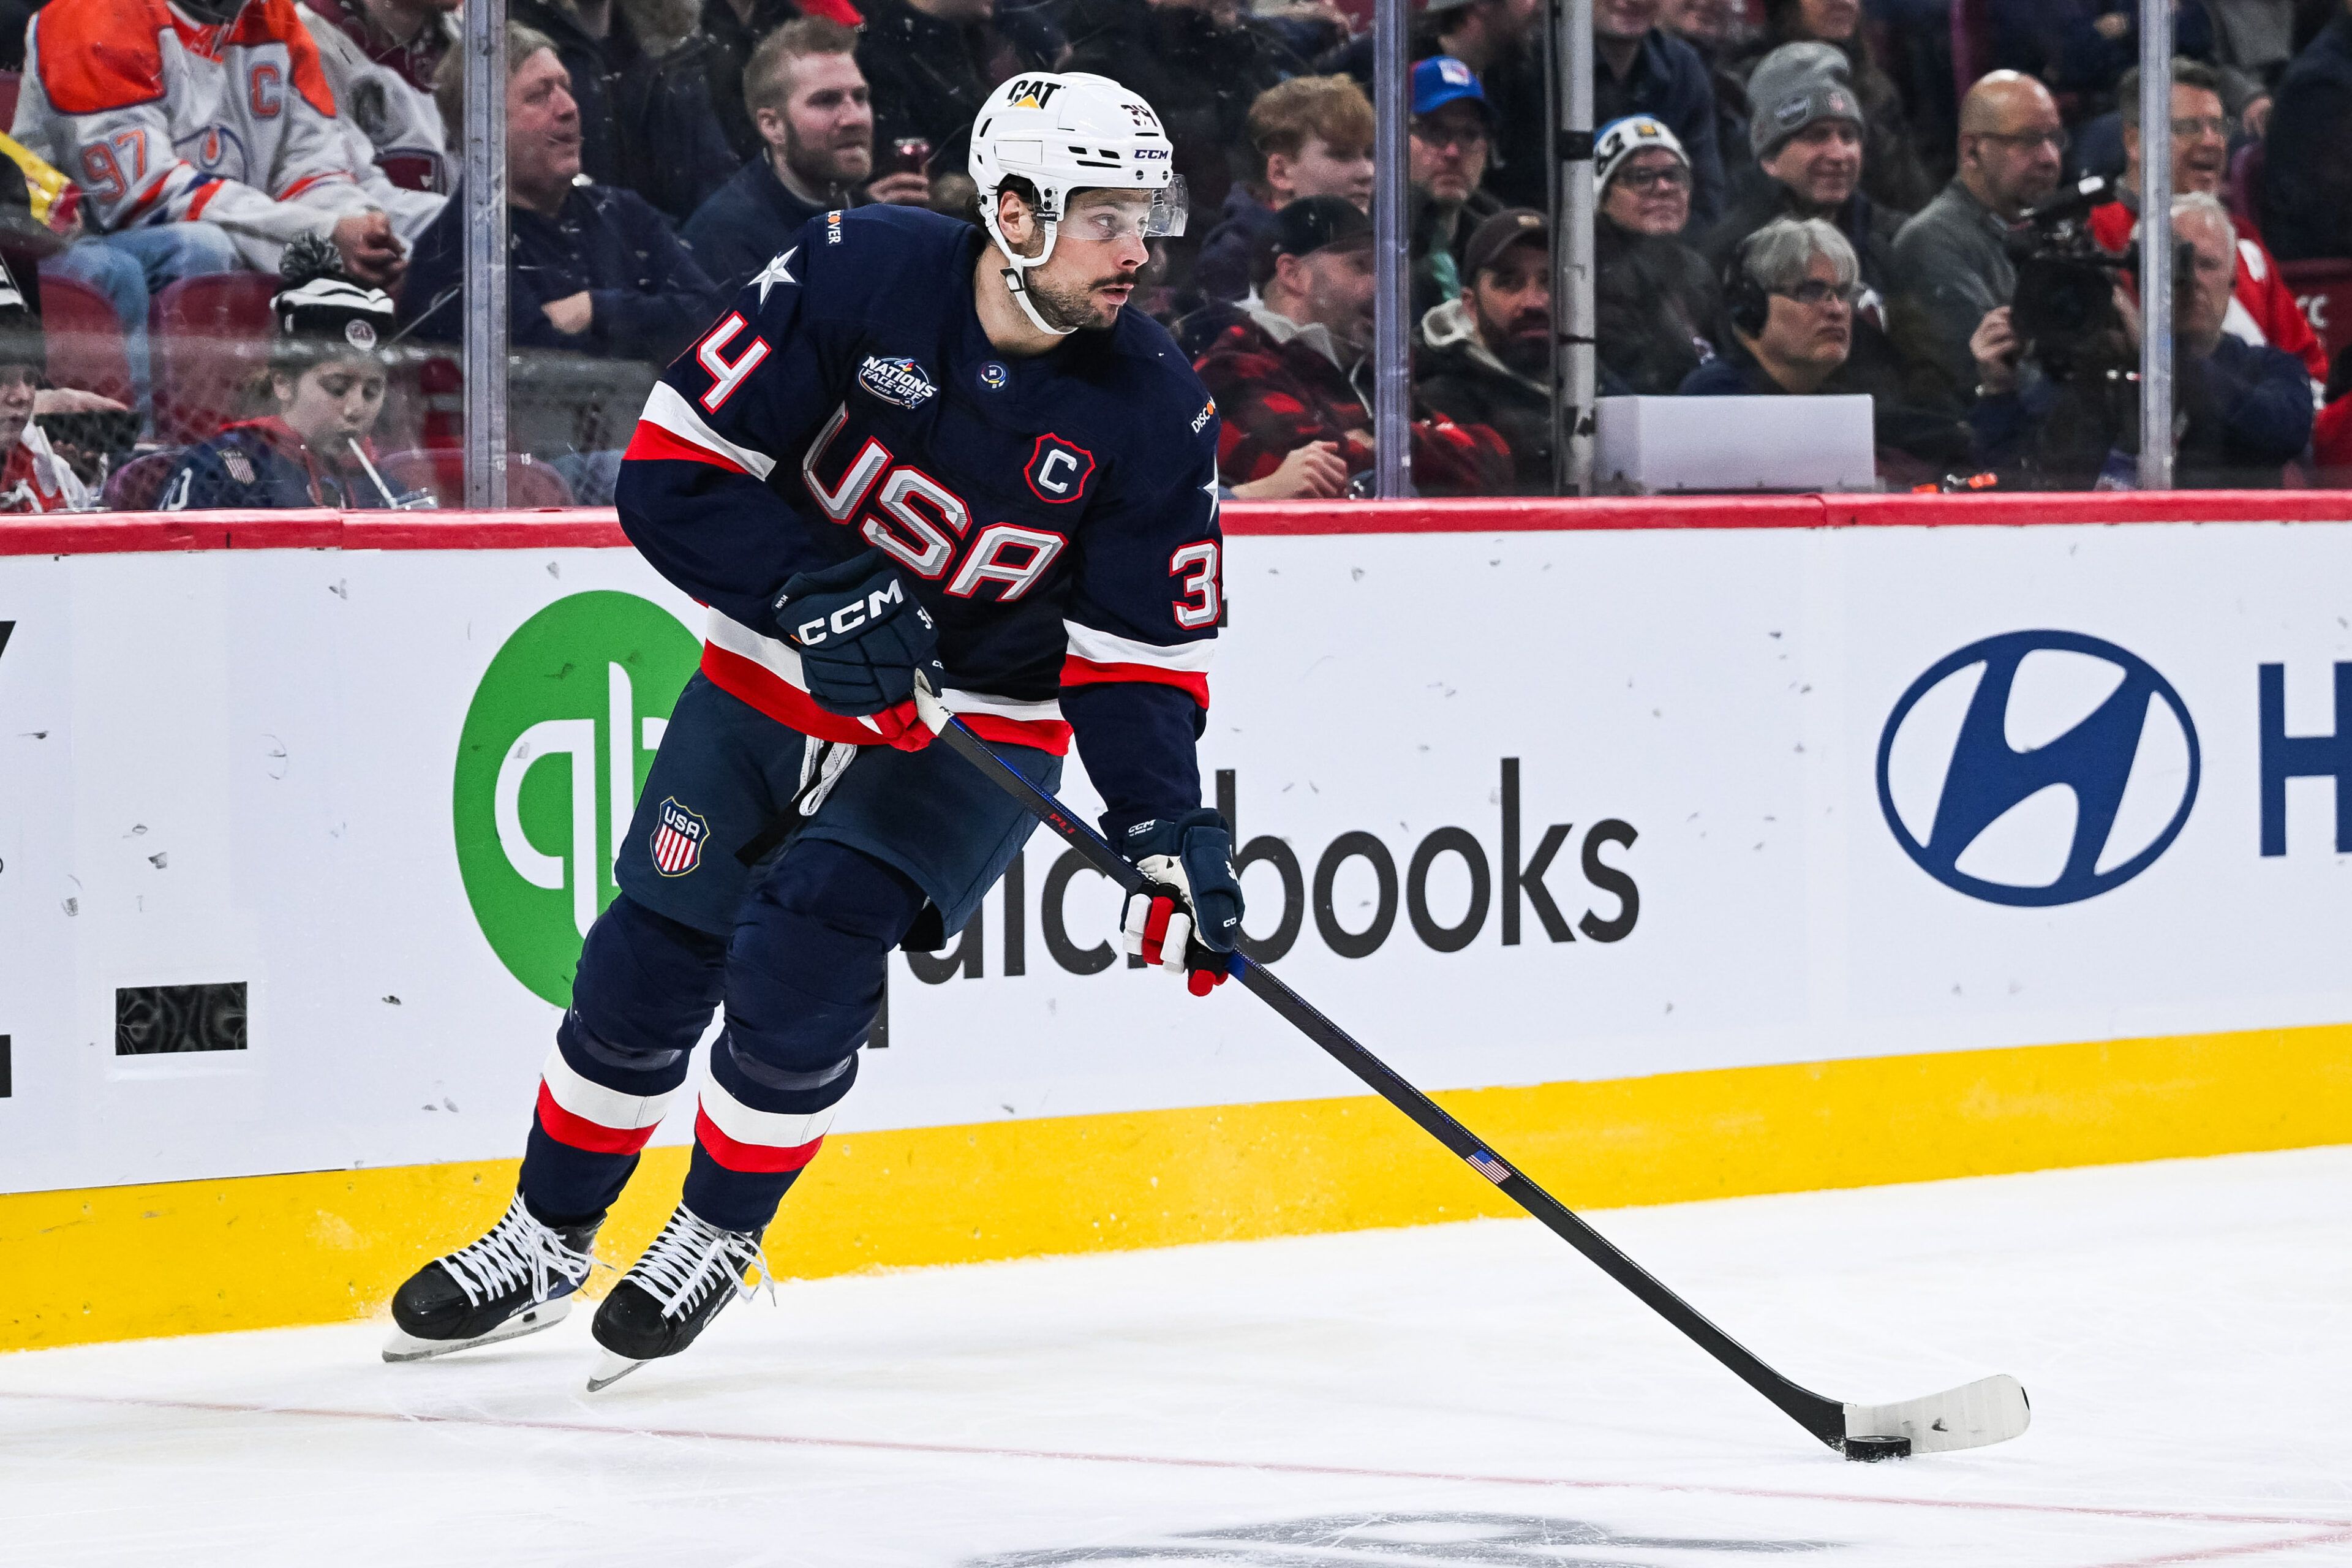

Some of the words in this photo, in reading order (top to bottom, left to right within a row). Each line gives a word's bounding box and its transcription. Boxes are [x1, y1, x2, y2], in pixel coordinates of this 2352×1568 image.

[248, 61, 281, 119] C
[1007, 80, 1062, 110] CAT
[81, 127, 148, 204] 97
[1134, 149, 1169, 159] CCM
[827, 210, 842, 244] COVER
[668, 308, 772, 415] 4
[862, 356, 937, 398] NATIONS
[862, 369, 924, 402] FACE-OFF
[874, 385, 892, 395] 2025
[1038, 448, 1077, 494] C
[802, 400, 1069, 603] USA
[798, 579, 903, 646] CCM
[664, 805, 700, 839] USA
[1128, 819, 1156, 834] CCM
